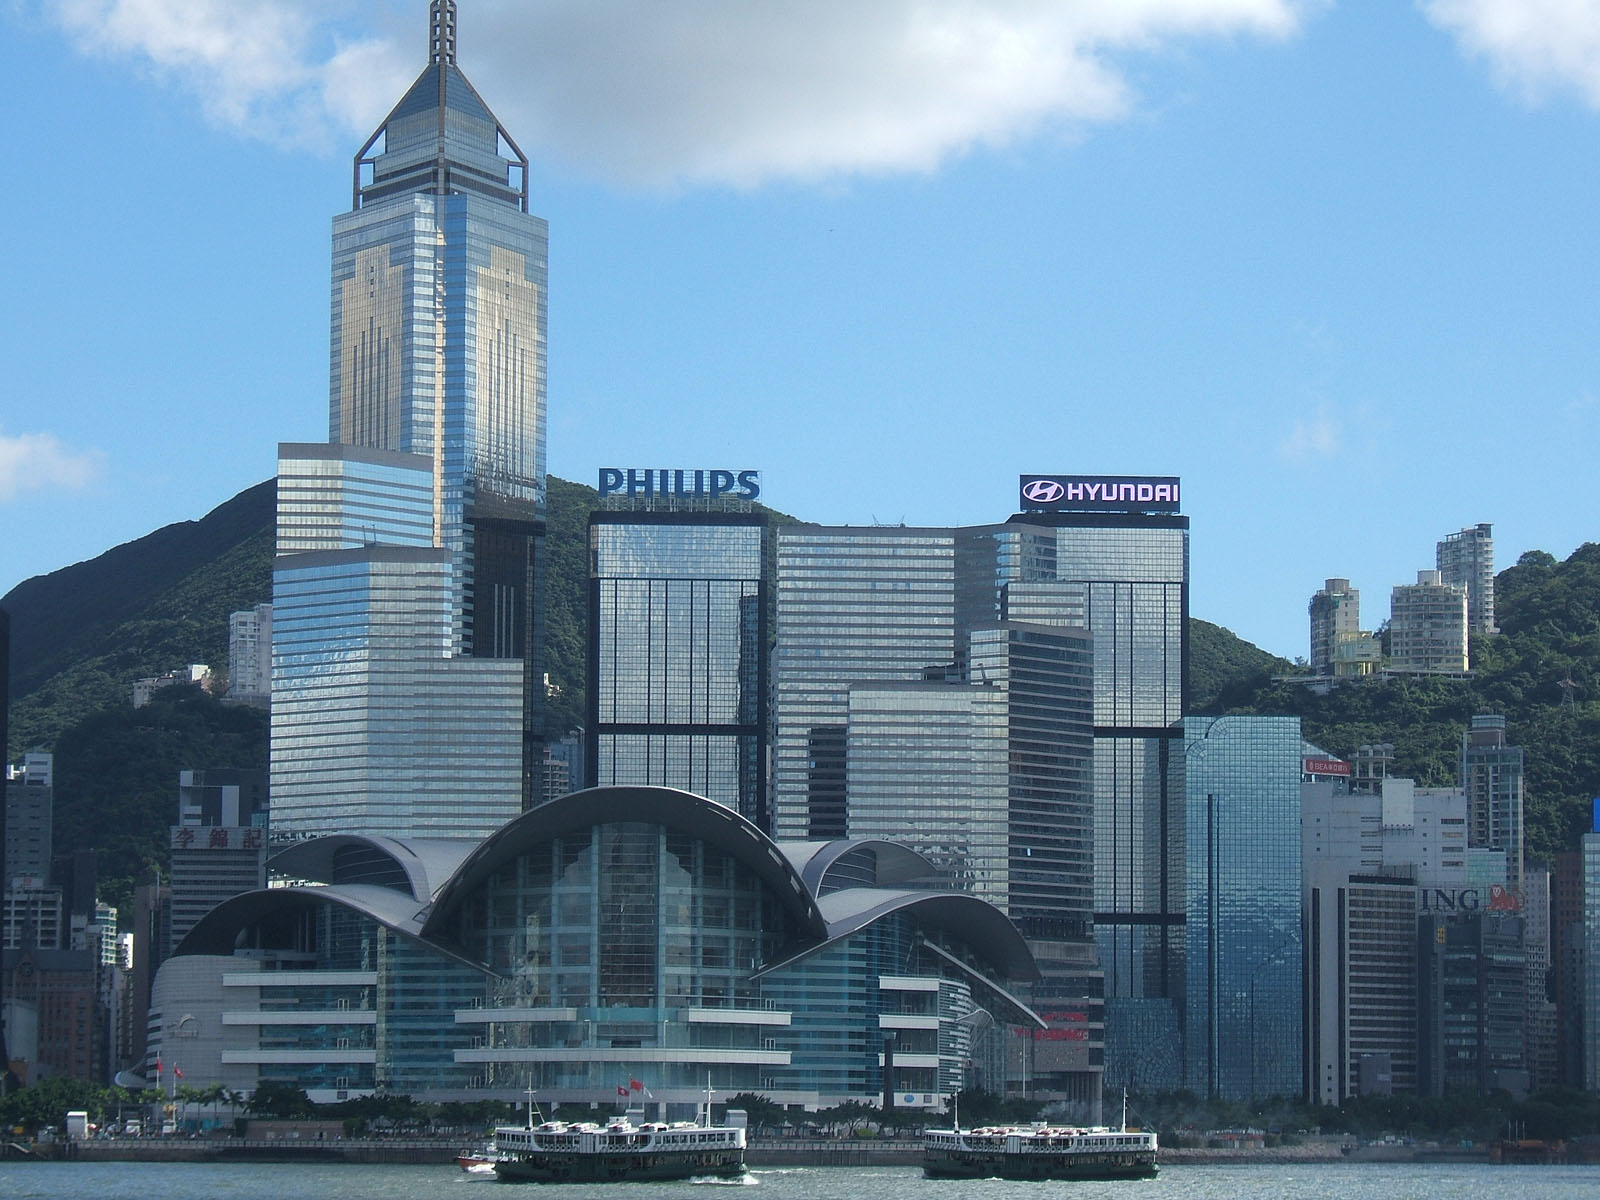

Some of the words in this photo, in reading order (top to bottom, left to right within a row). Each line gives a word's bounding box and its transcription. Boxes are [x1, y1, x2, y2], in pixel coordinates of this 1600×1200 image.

[599, 468, 760, 499] PHILIPS
[1068, 483, 1178, 501] HYUNDAI
[1423, 889, 1479, 911] ING
